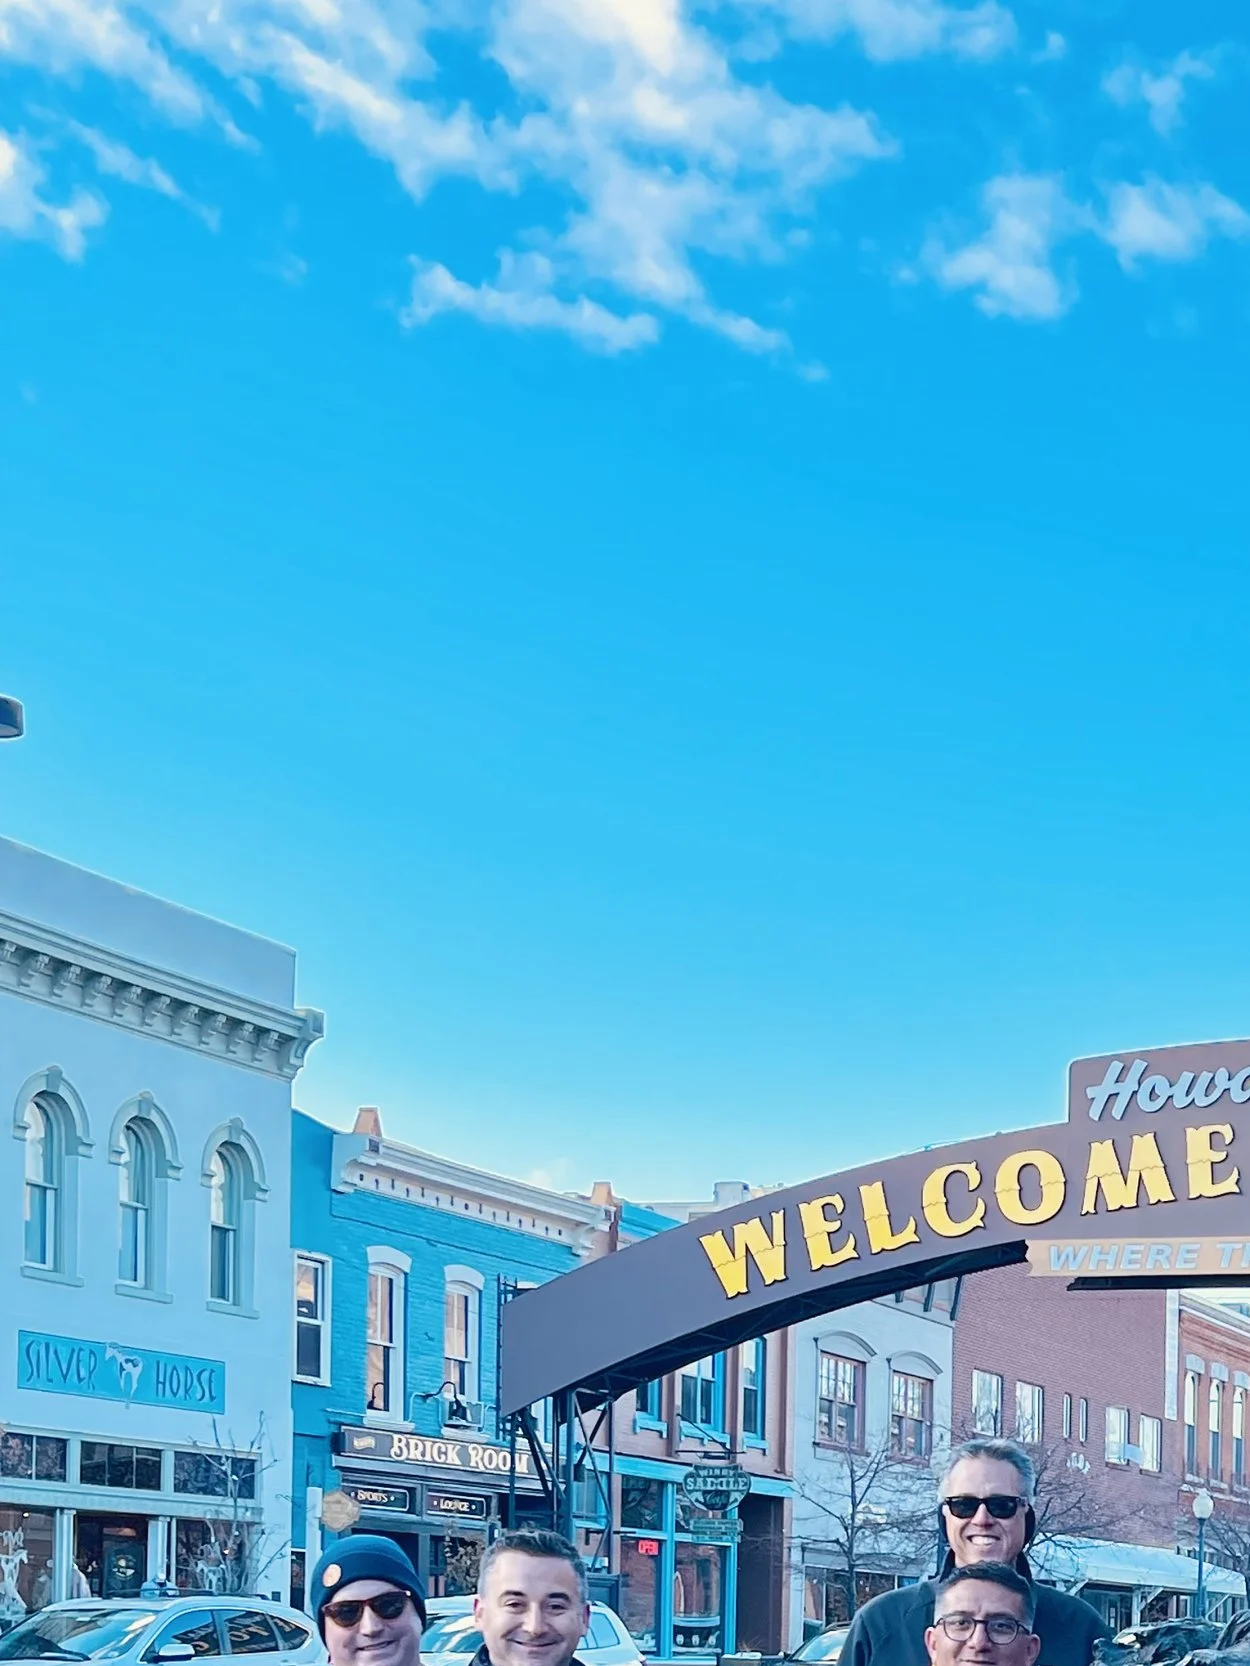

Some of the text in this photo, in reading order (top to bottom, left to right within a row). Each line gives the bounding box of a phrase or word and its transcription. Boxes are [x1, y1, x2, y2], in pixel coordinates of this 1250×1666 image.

[698, 1122, 1241, 1299] WELCOME
[1049, 1243, 1199, 1273] WHERE
[155, 1360, 217, 1403] HORSE
[390, 1434, 463, 1466] BRICK
[468, 1443, 530, 1473] ROOM
[686, 1477, 748, 1490] SADDLE
